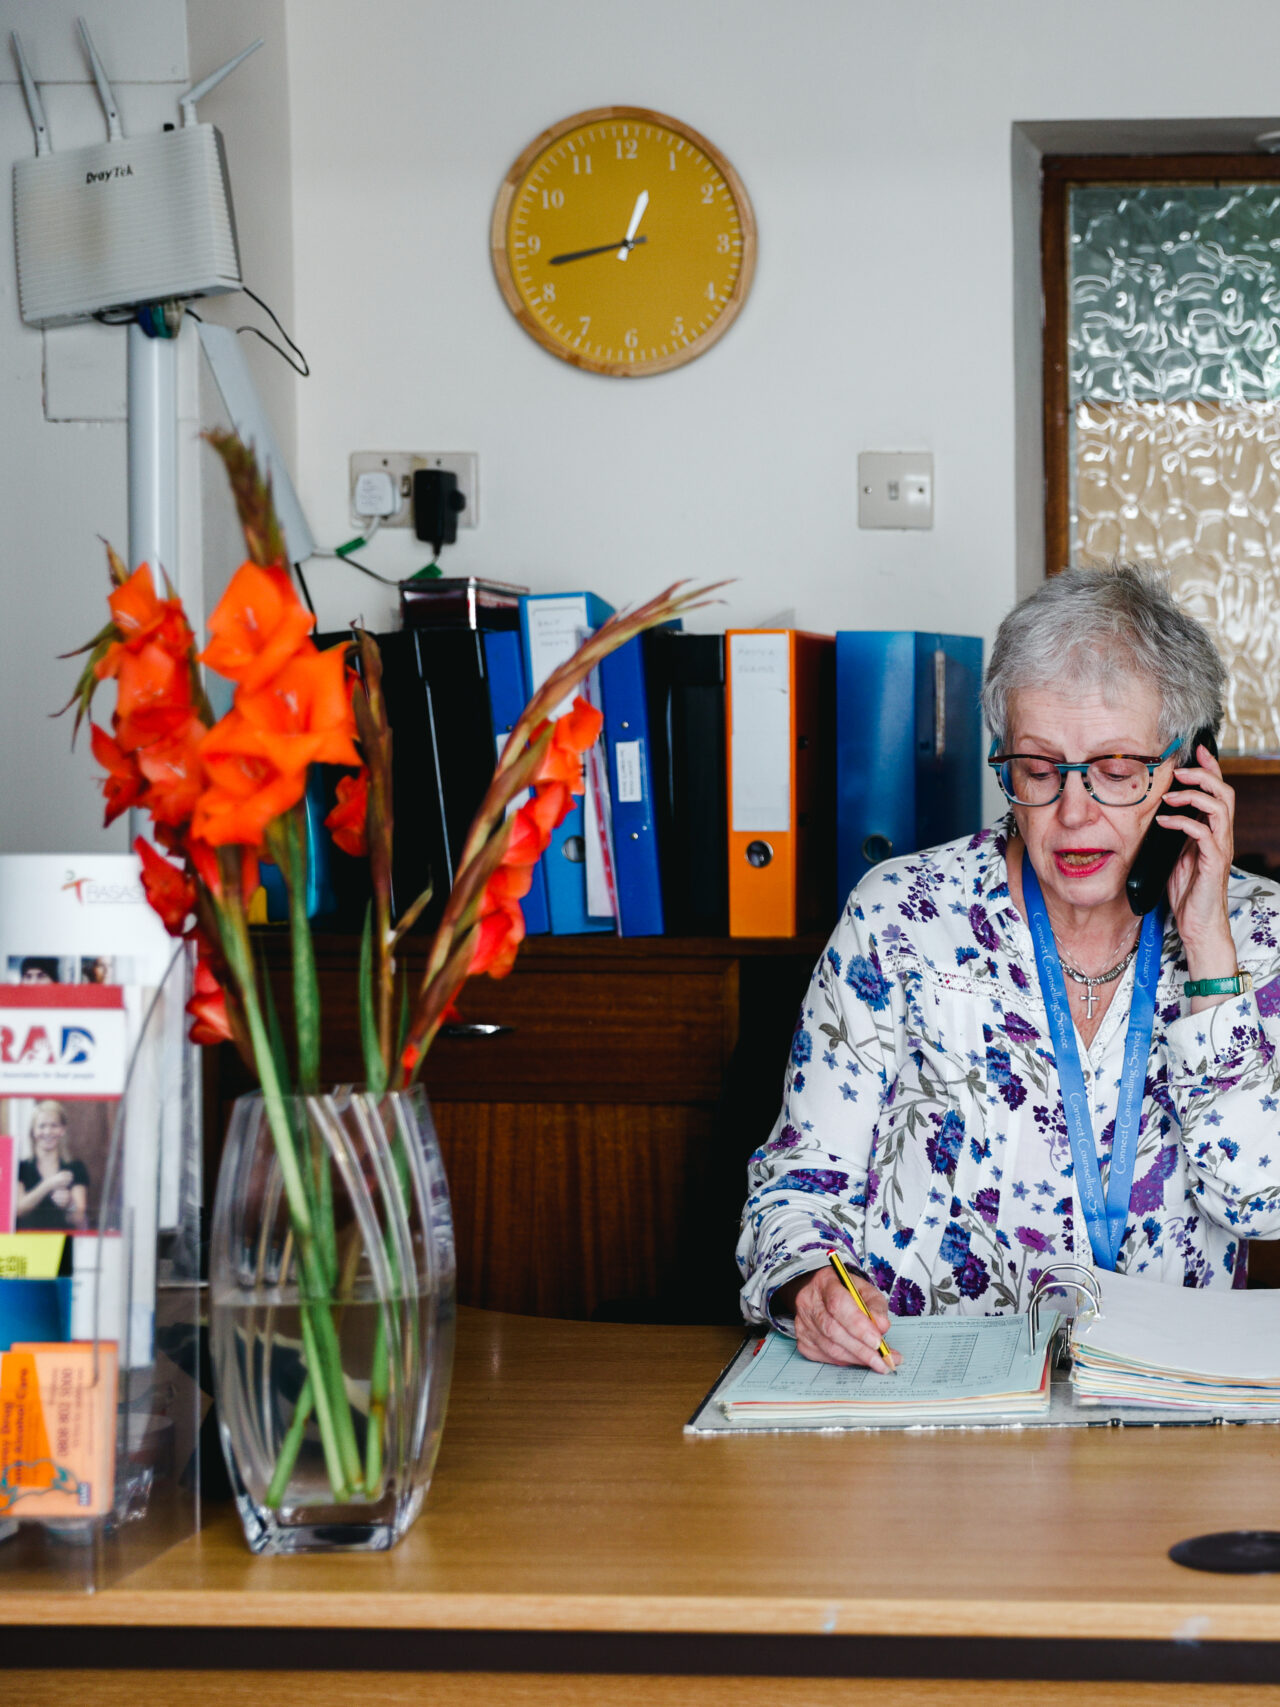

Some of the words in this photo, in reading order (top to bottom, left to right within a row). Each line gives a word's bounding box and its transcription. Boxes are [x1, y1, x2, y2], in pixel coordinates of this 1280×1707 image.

[616, 139, 638, 160] 12
[573, 154, 592, 175] 11
[668, 152, 676, 171] 1
[542, 189, 564, 210] 10
[701, 183, 714, 204] 2
[527, 235, 541, 255] 9
[717, 233, 730, 253] 3
[542, 283, 556, 303] 8
[579, 316, 591, 336] 7
[671, 316, 685, 336] 5
[624, 328, 638, 348] 6
[1033, 912, 1049, 954] Connect
[1042, 955, 1062, 1012] Counselling
[1053, 1010, 1068, 1049] Service
[1127, 1030, 1142, 1069] Service
[1119, 1069, 1139, 1129] Counselling
[1113, 1129, 1129, 1175] Connect
[1069, 1092, 1086, 1137] Connect
[1078, 1138, 1097, 1200] Counselling
[1088, 1200, 1102, 1238] Service
